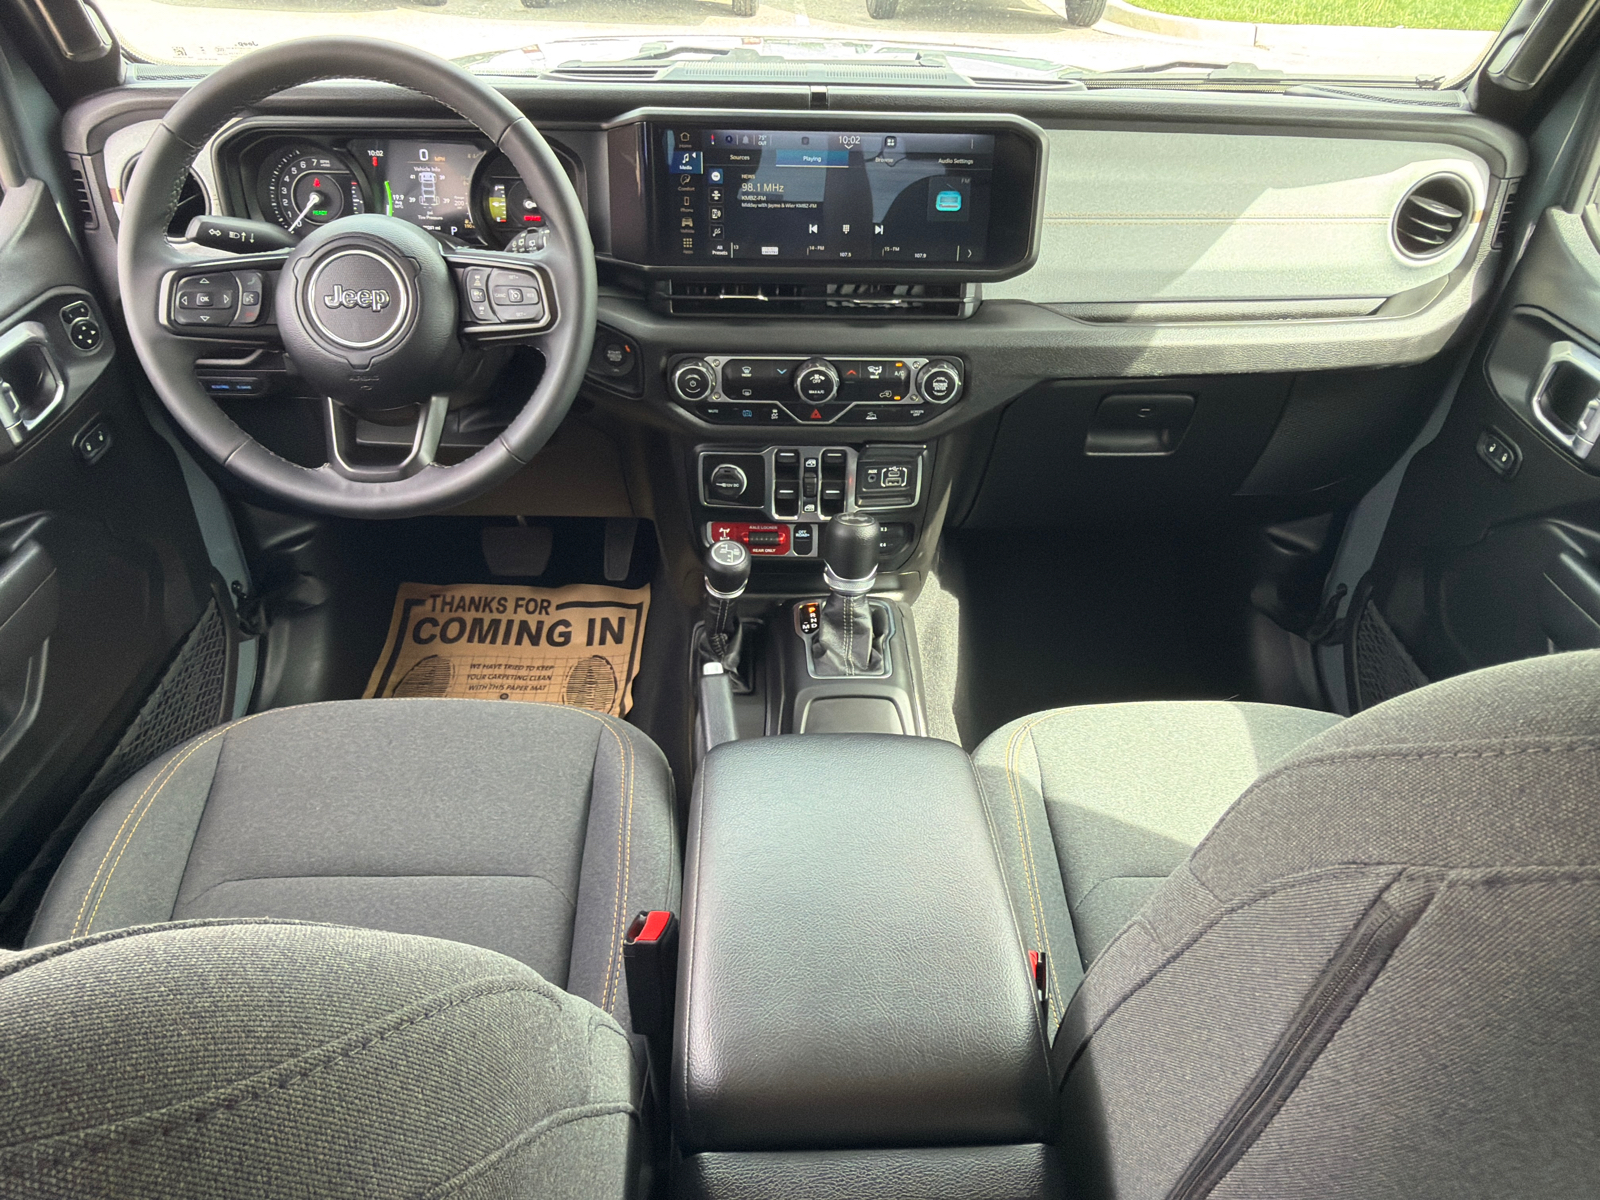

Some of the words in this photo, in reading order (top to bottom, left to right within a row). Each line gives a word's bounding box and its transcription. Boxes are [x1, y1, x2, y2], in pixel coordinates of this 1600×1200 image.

[839, 136, 860, 144] 10:02
[419, 149, 429, 161] 0
[300, 161, 307, 169] 6
[282, 187, 288, 195] 3
[742, 183, 761, 192] 98.1
[764, 184, 784, 192] MHz
[451, 226, 458, 236] P
[324, 284, 390, 312] Jeep
[430, 594, 508, 614] THANKS
[514, 597, 551, 615] FOR
[412, 616, 573, 647] COMING
[586, 616, 626, 647] IN
